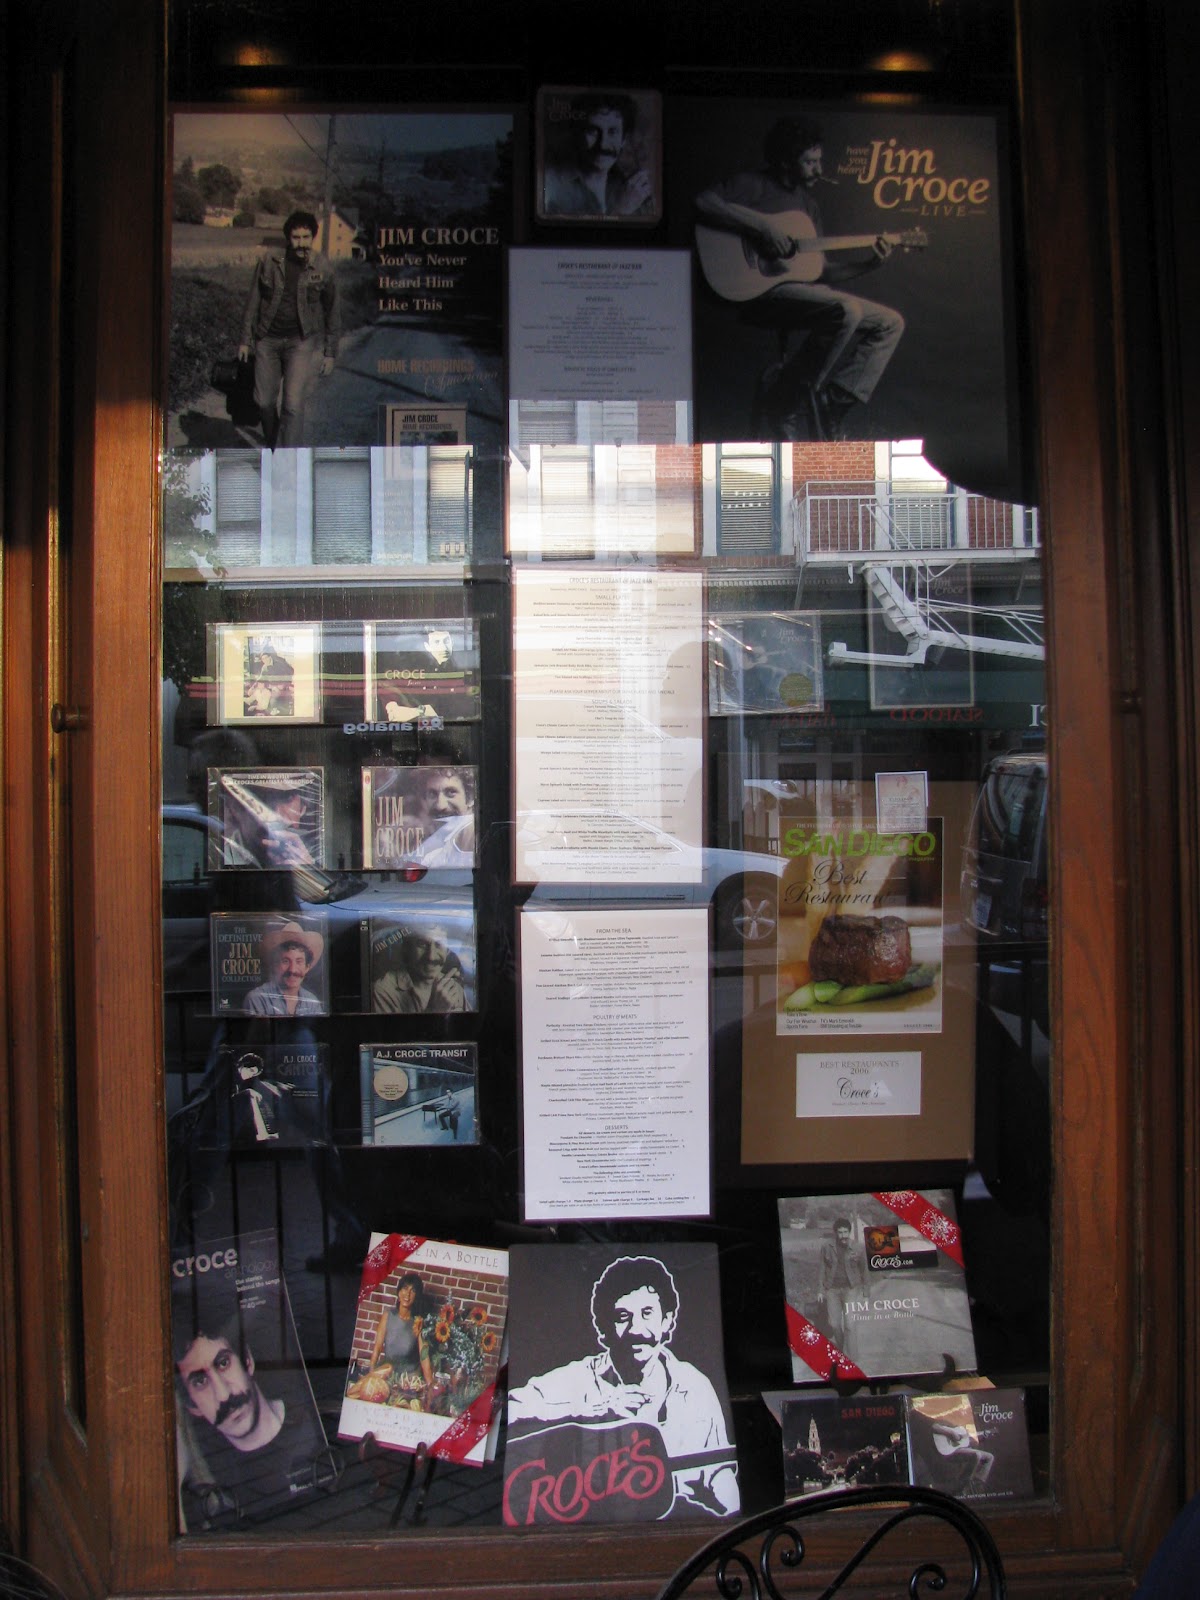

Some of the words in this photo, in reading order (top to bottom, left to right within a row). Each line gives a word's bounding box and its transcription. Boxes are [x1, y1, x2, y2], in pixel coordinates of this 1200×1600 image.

[846, 145, 869, 156] have
[849, 156, 868, 168] you
[857, 137, 937, 184] Jim
[837, 163, 867, 176] heard
[872, 175, 991, 209] Croce
[919, 205, 967, 217] LIVE
[378, 227, 414, 249] JIM
[421, 227, 499, 246] CROCE
[379, 253, 422, 267] You've
[426, 254, 467, 267] Never
[378, 276, 421, 289] Heard
[425, 276, 454, 289] Him
[378, 299, 409, 312] Like
[412, 298, 443, 312] This
[401, 414, 416, 423] JIM
[417, 414, 438, 423] CROCE
[384, 668, 426, 680] CROCE
[375, 796, 404, 827] JIM
[376, 827, 425, 858] CROCE
[782, 828, 844, 857] SAN
[847, 829, 937, 857] DIEGO
[813, 859, 868, 886] Best
[218, 933, 264, 943] DEFINITIVE
[229, 942, 253, 959] JIM
[222, 958, 261, 976] CROCE
[221, 975, 262, 983] COLLECTION
[376, 1050, 392, 1058] A.J.
[394, 1050, 427, 1058] CROCE
[429, 1049, 468, 1057] TRANSIT
[820, 1061, 840, 1069] BEST
[841, 1060, 900, 1068] RESTAURANTS
[836, 1076, 880, 1099] Croce's
[172, 1247, 238, 1278] croce
[425, 1248, 438, 1258] IN
[442, 1251, 451, 1261] A
[456, 1250, 499, 1268] BOTTLE
[844, 1301, 869, 1315] JIM
[873, 1297, 920, 1311] CROCE
[841, 1408, 862, 1419] SAN
[866, 1406, 895, 1418] DIEGO
[978, 1402, 999, 1417] Jim
[983, 1411, 1014, 1423] Croce
[502, 1429, 666, 1527] CROCE'S
